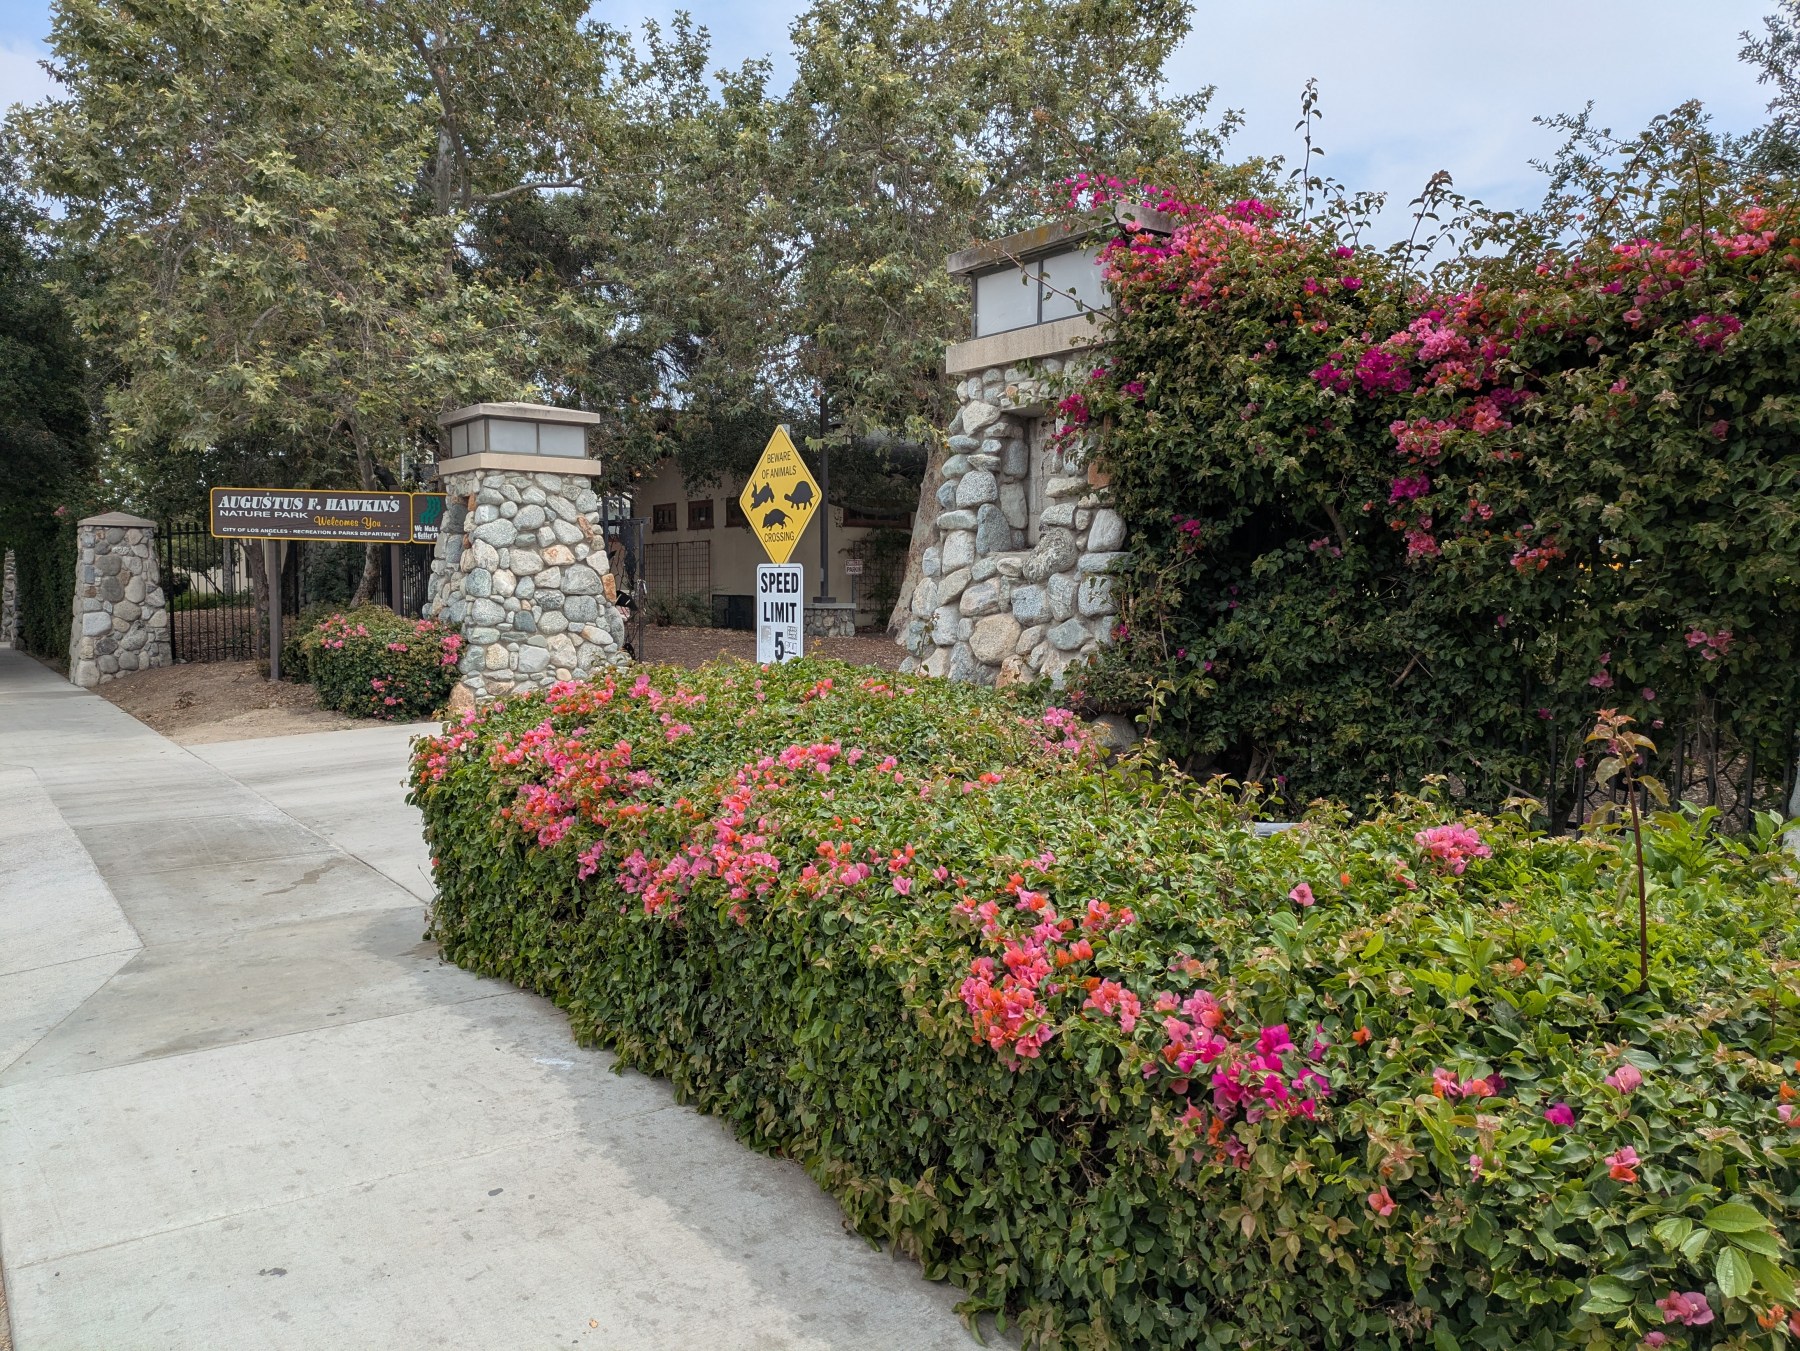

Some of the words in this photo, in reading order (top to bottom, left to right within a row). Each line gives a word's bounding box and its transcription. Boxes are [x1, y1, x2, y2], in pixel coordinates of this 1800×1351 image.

[767, 451, 791, 463] BEWARE
[762, 469, 769, 479] OF
[771, 465, 797, 478] ANIMALS
[218, 495, 303, 510] AUGUSTUS
[307, 498, 321, 511] F.
[324, 498, 400, 513] HAWKINS
[219, 510, 271, 518] NATURE
[275, 511, 308, 519] PARK
[313, 515, 359, 527] Welcomes
[361, 516, 381, 530] You
[764, 531, 795, 543] CROSSING
[760, 572, 799, 594] SPEED
[763, 601, 797, 623] LIMIT
[774, 631, 785, 661] 5
